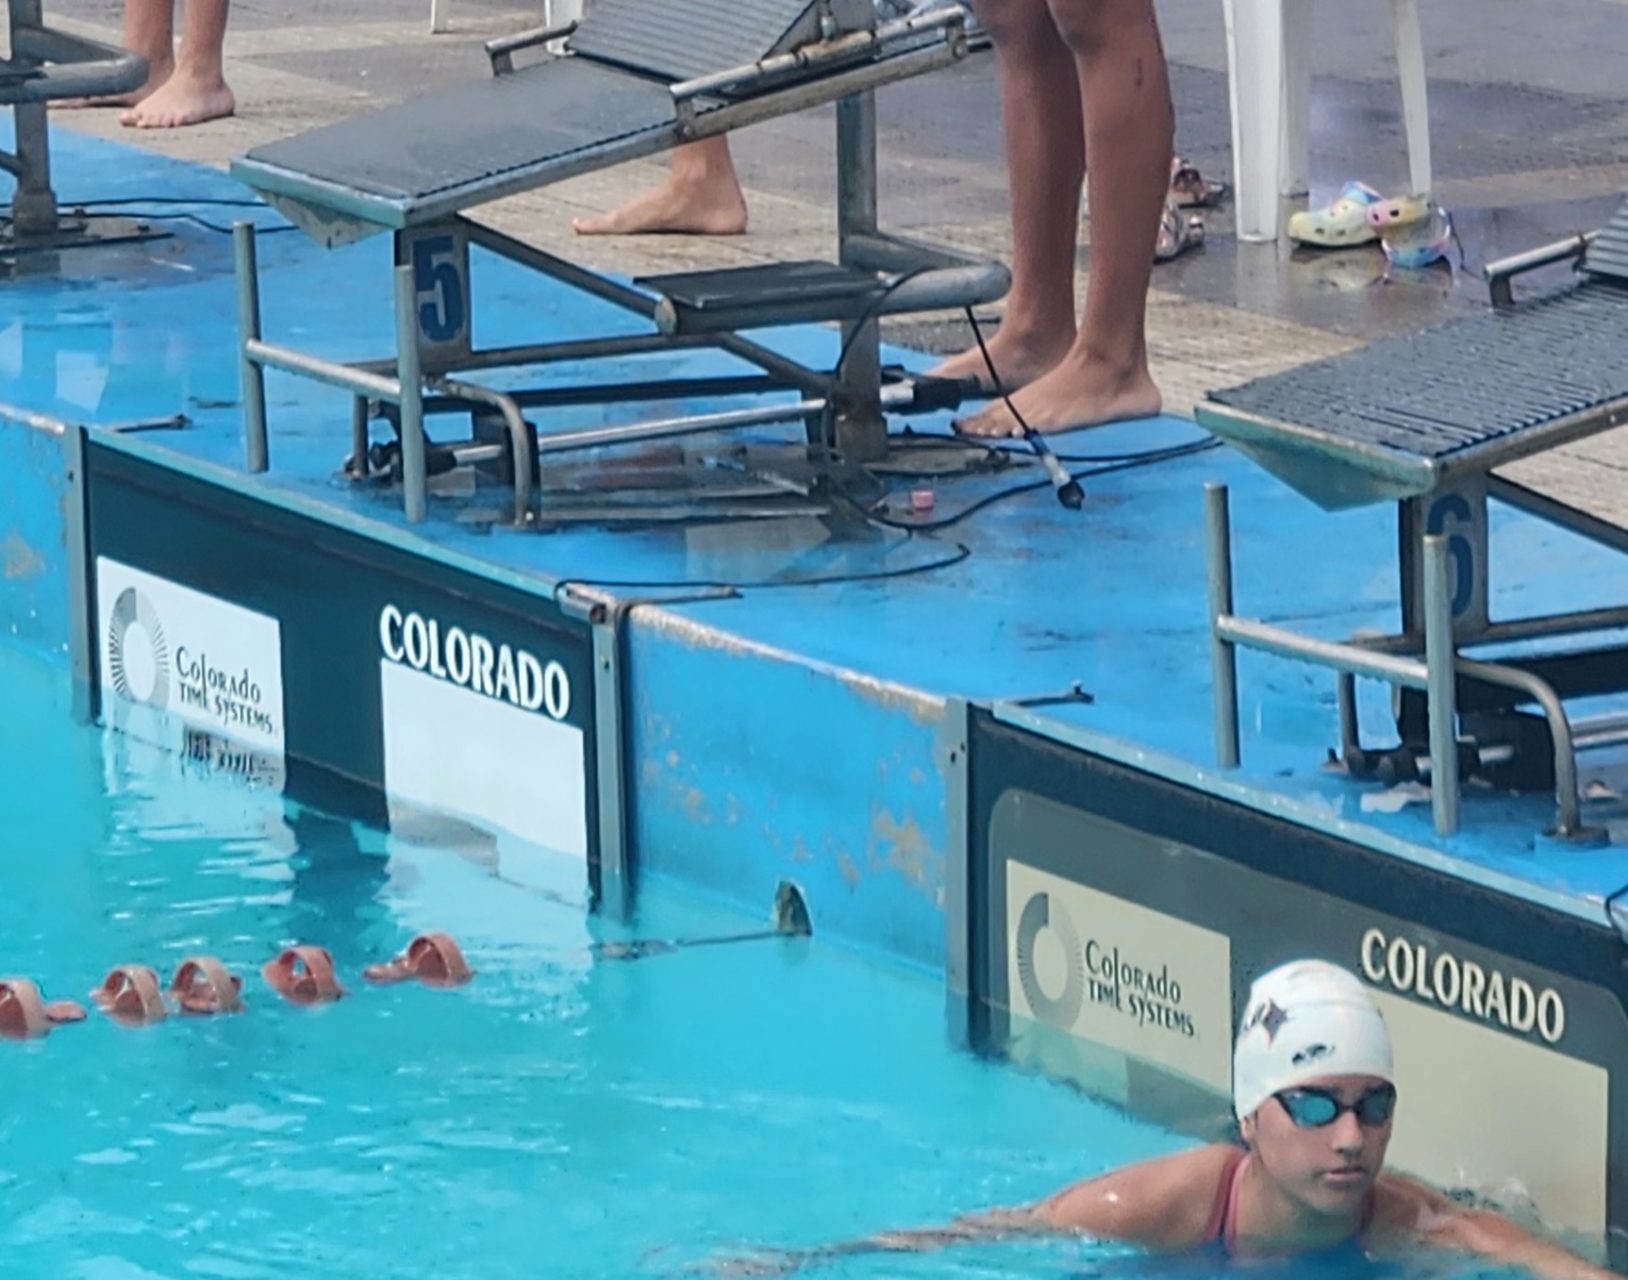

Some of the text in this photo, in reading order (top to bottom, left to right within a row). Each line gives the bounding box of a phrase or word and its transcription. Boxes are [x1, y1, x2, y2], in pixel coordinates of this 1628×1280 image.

[413, 235, 464, 342] 5
[1427, 495, 1473, 616] 6
[215, 694, 273, 734] SYSTEMS
[380, 604, 570, 720] COLORADO
[1088, 977, 1194, 1037] TIME SYSTEMS
[1361, 928, 1565, 1043] COLORADO
